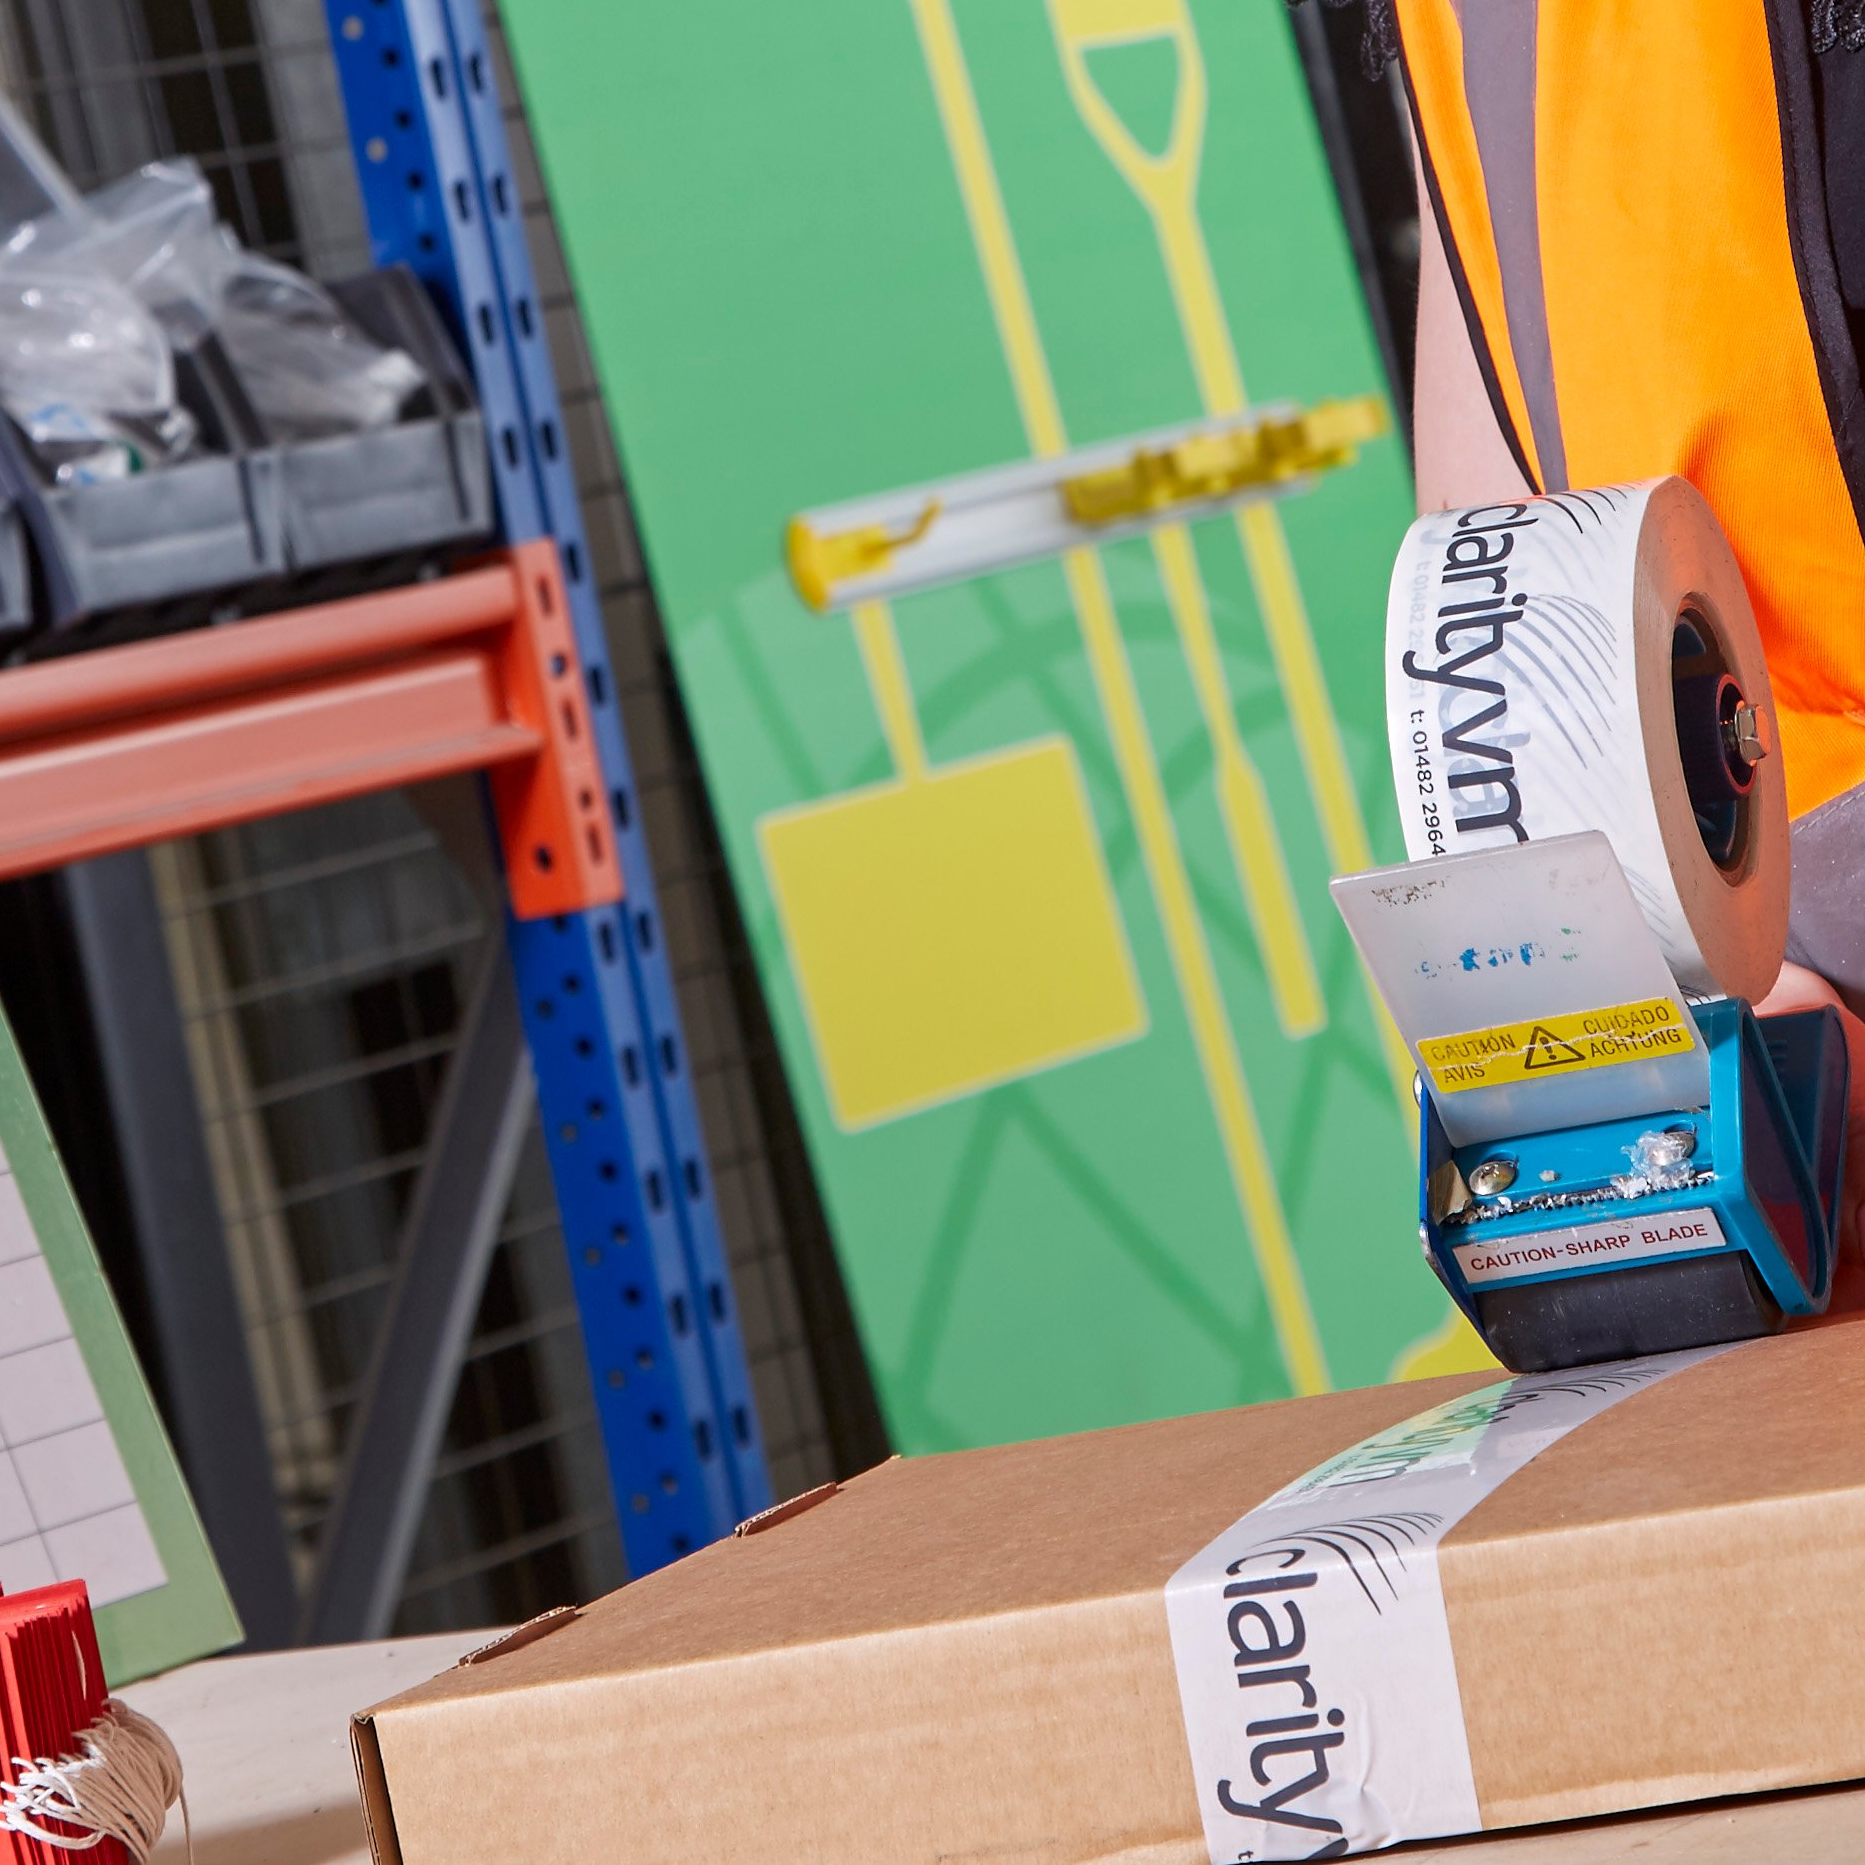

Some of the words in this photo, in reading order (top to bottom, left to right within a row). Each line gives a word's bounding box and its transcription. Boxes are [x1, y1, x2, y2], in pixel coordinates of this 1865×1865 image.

[1412, 731, 1434, 796] 01482
[1422, 803, 1447, 857] 2964
[1583, 1006, 1670, 1035] CUIDADO
[1432, 1034, 1517, 1062] CAUTION
[1590, 1028, 1682, 1058] ACHTUNG
[1444, 1064, 1485, 1083] AVIS
[1470, 1235, 1631, 1271] CAUTION-SHARP
[1642, 1224, 1708, 1244] BLADE
